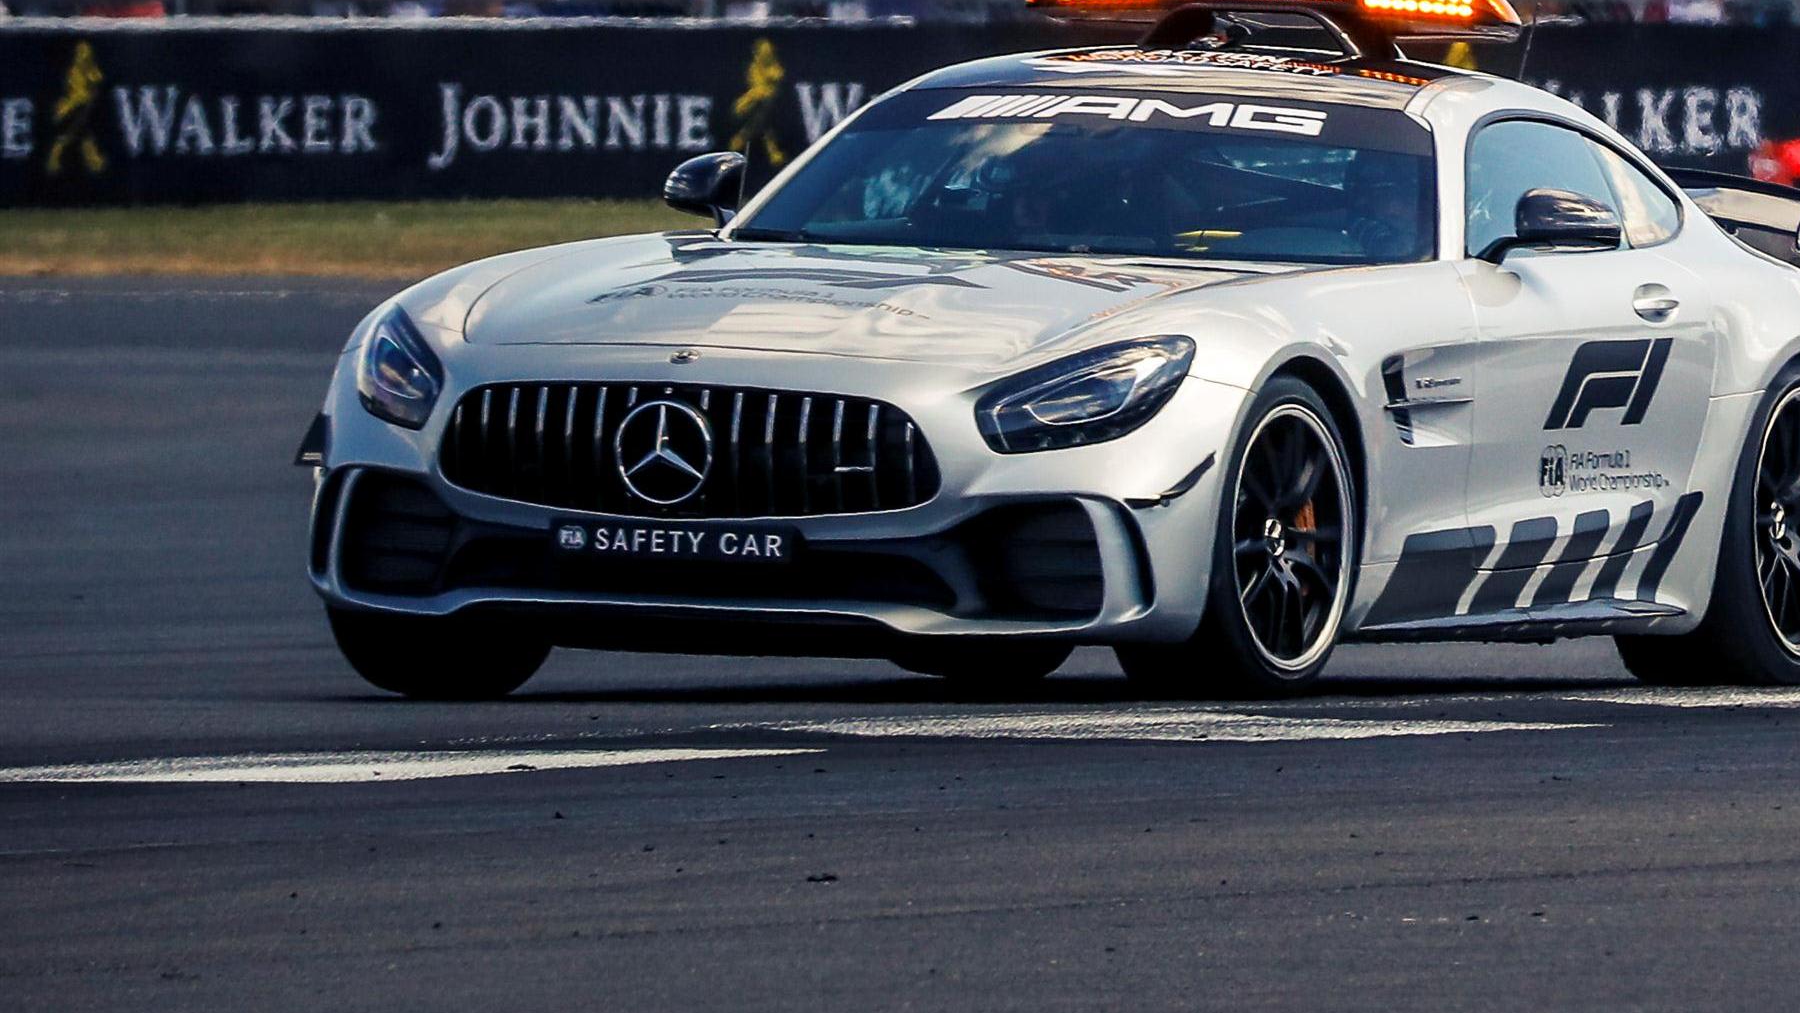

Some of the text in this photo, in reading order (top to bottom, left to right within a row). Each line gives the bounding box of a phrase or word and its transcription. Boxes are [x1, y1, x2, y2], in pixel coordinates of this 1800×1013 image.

[115, 85, 377, 155] WALKER
[429, 83, 711, 170] JOHNNIE
[1543, 338, 1673, 430] F1
[1540, 456, 1564, 486] FIA
[1587, 450, 1624, 469] Formula
[1599, 471, 1663, 491] Championship
[594, 528, 706, 554] SAFETY
[719, 533, 783, 557] CAR
